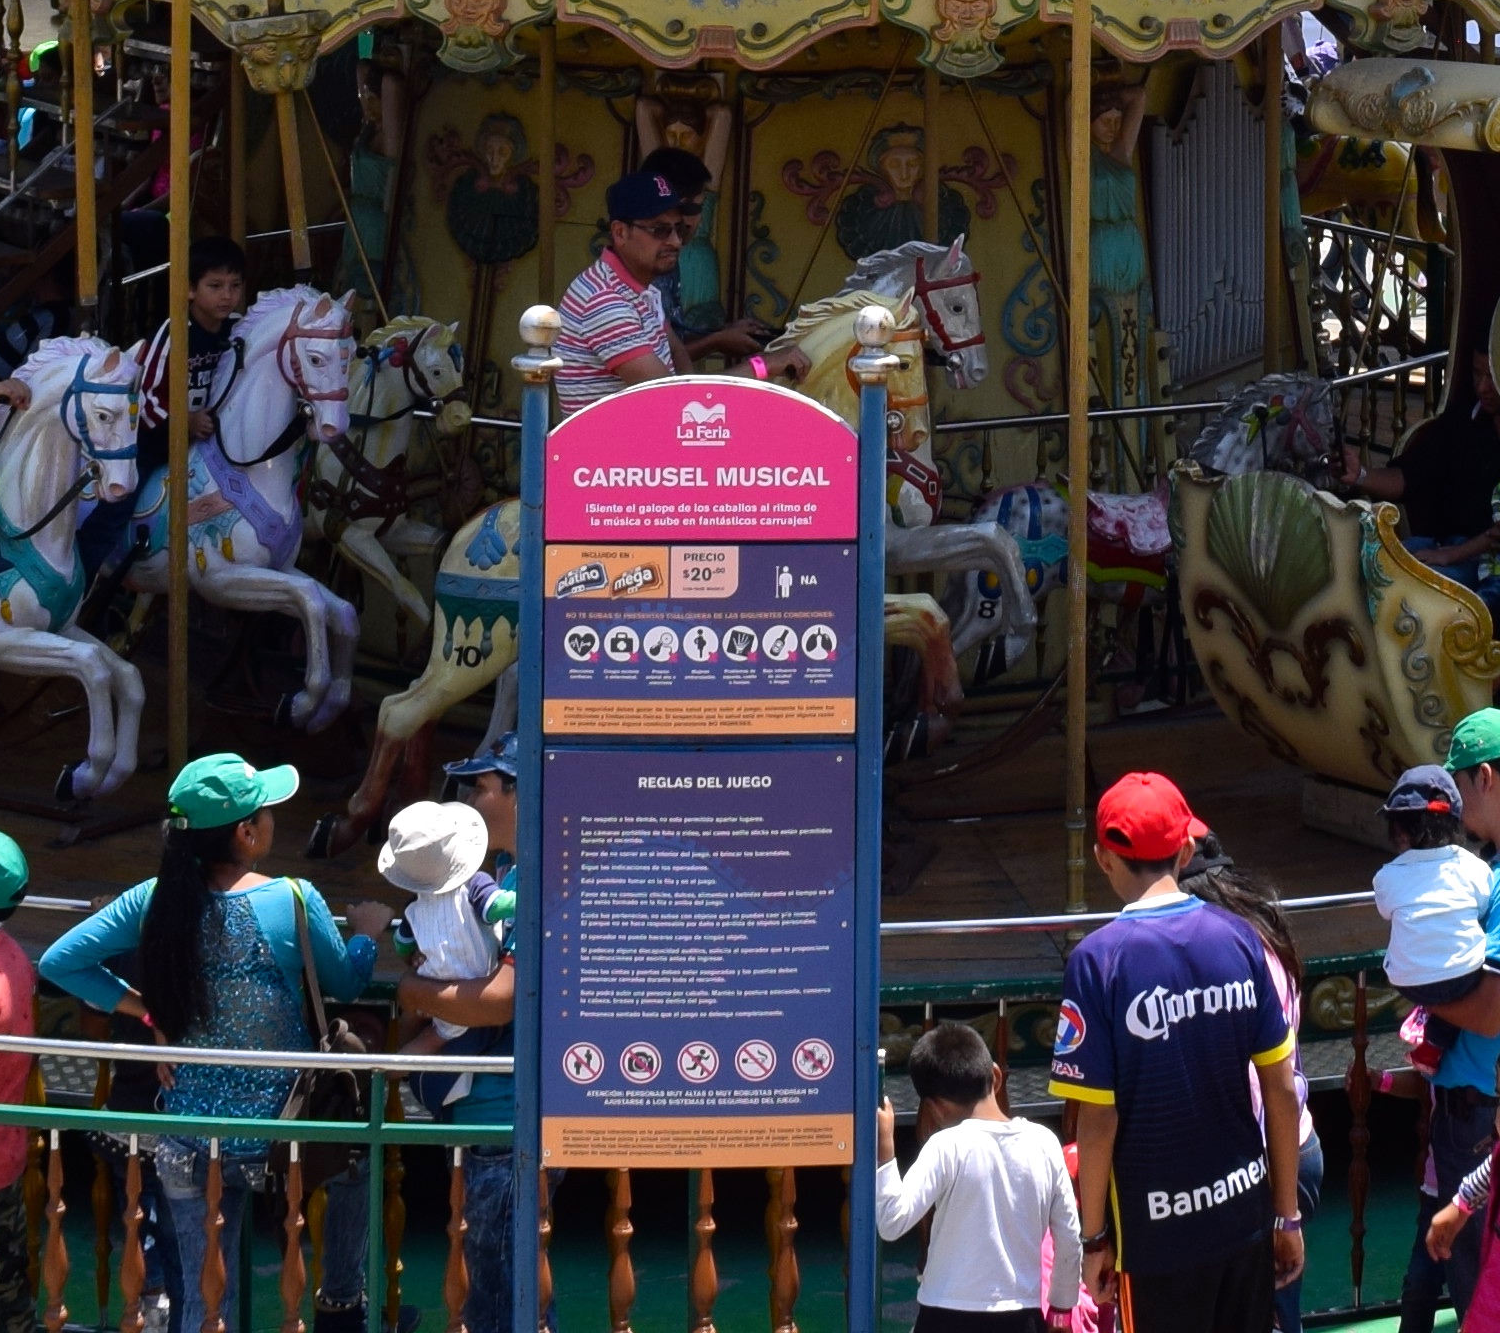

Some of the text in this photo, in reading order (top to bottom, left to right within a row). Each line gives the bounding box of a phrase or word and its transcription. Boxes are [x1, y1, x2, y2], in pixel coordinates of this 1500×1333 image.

[676, 425, 731, 439] La Feria
[573, 465, 831, 488] CARRUSEL MUSICAL
[626, 502, 635, 513] el
[678, 502, 691, 513] de
[694, 502, 710, 513] los
[804, 501, 818, 512] de
[684, 552, 726, 562] PRECIO
[558, 565, 600, 592] platino
[613, 568, 653, 590] mega
[800, 575, 818, 586] NA
[978, 600, 998, 620] 8
[454, 645, 482, 668] 10
[638, 775, 772, 789] REGLAS DEL JUEGO
[1126, 979, 1258, 1040] Corona
[1147, 1153, 1269, 1221] Banamex
